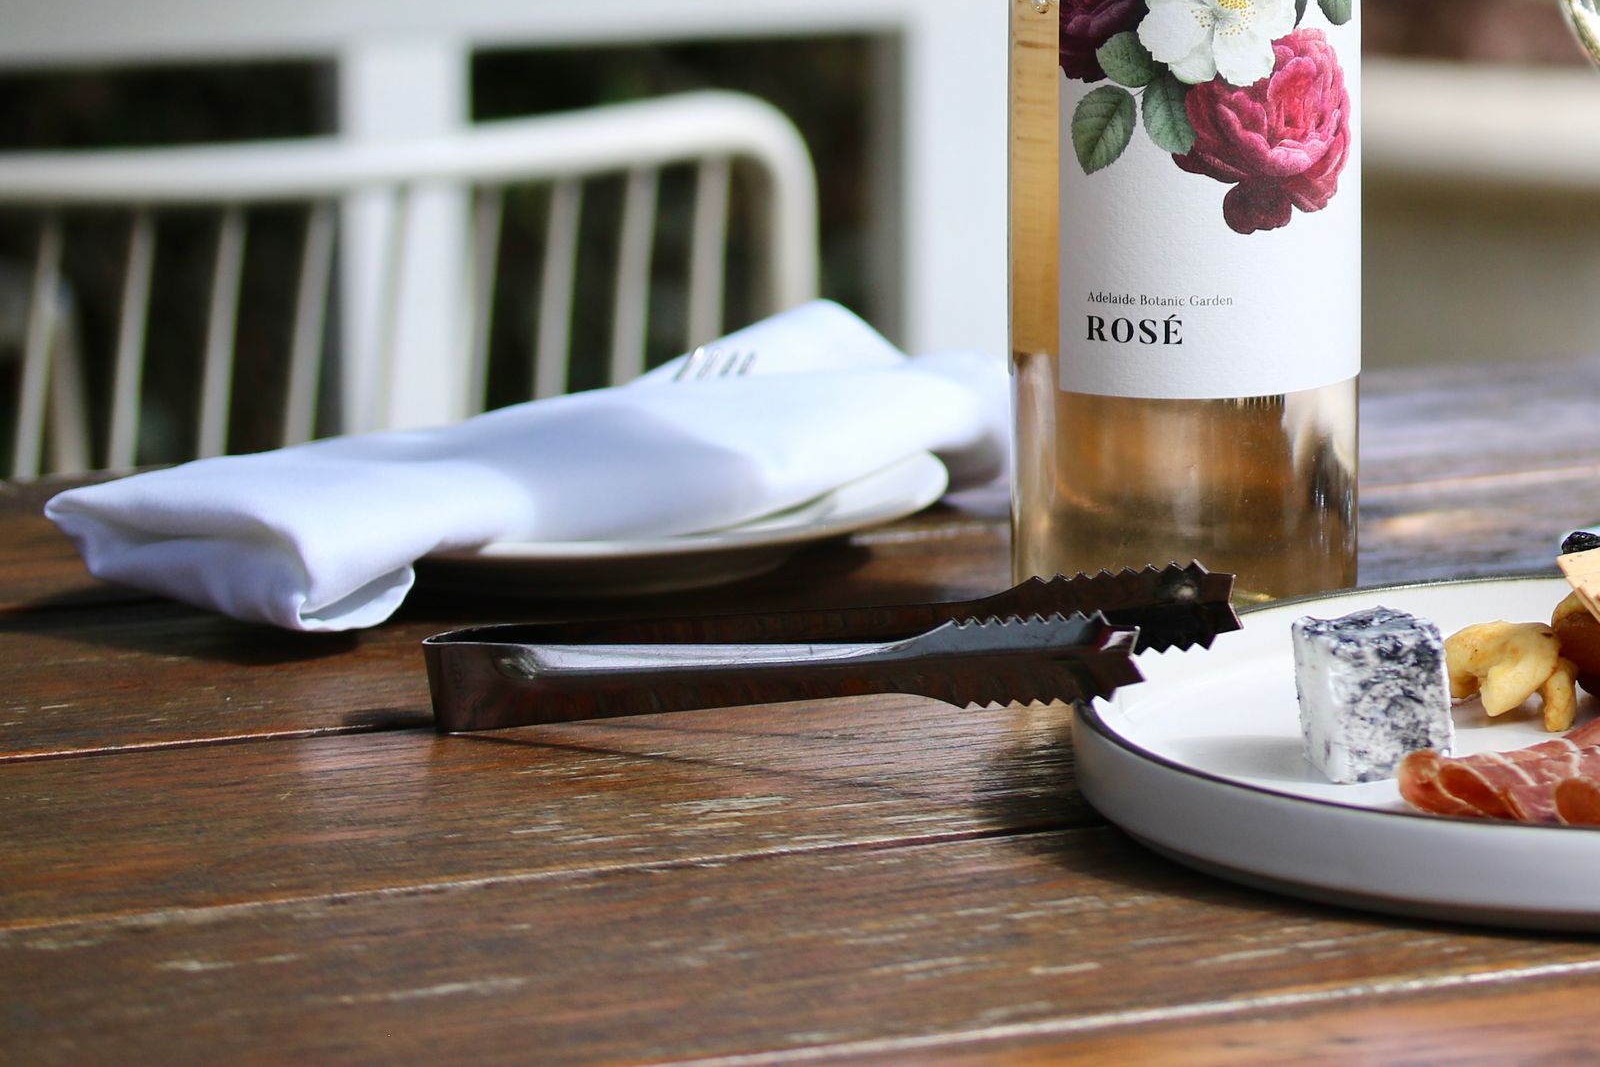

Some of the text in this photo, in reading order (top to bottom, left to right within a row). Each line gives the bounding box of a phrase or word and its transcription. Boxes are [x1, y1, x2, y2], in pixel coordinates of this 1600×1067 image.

[1087, 291, 1233, 306] Adelaide Botanic Garden
[1086, 314, 1183, 345] ROSÉ
